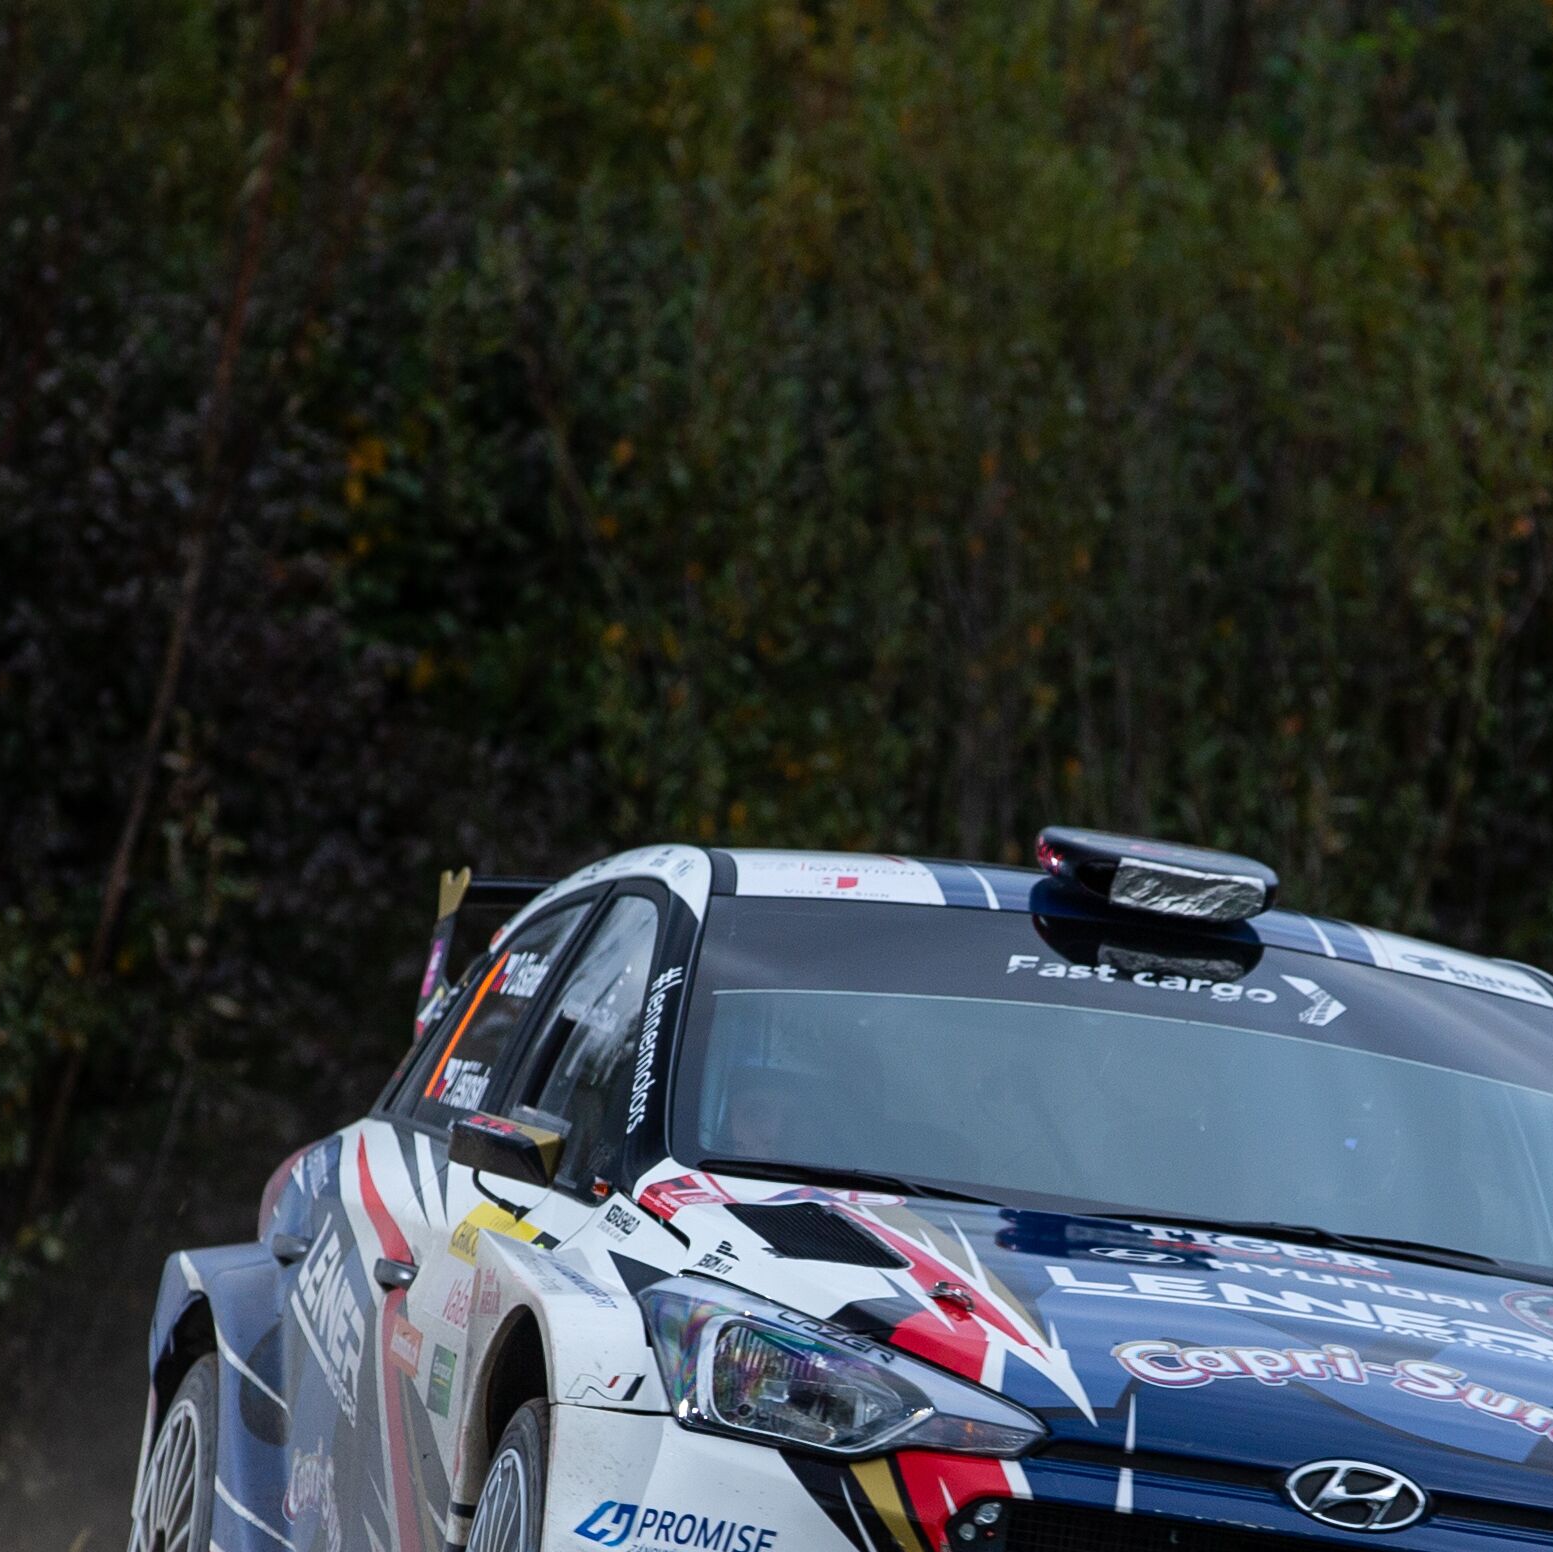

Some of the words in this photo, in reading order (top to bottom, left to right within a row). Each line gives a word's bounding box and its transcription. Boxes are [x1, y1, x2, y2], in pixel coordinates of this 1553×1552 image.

[1006, 954, 1118, 983] Fast
[626, 966, 684, 1135] #lennermotors
[1131, 1223, 1391, 1275] TIGER
[298, 1211, 366, 1404] LENNER
[1205, 1258, 1491, 1314] HYUNDAI
